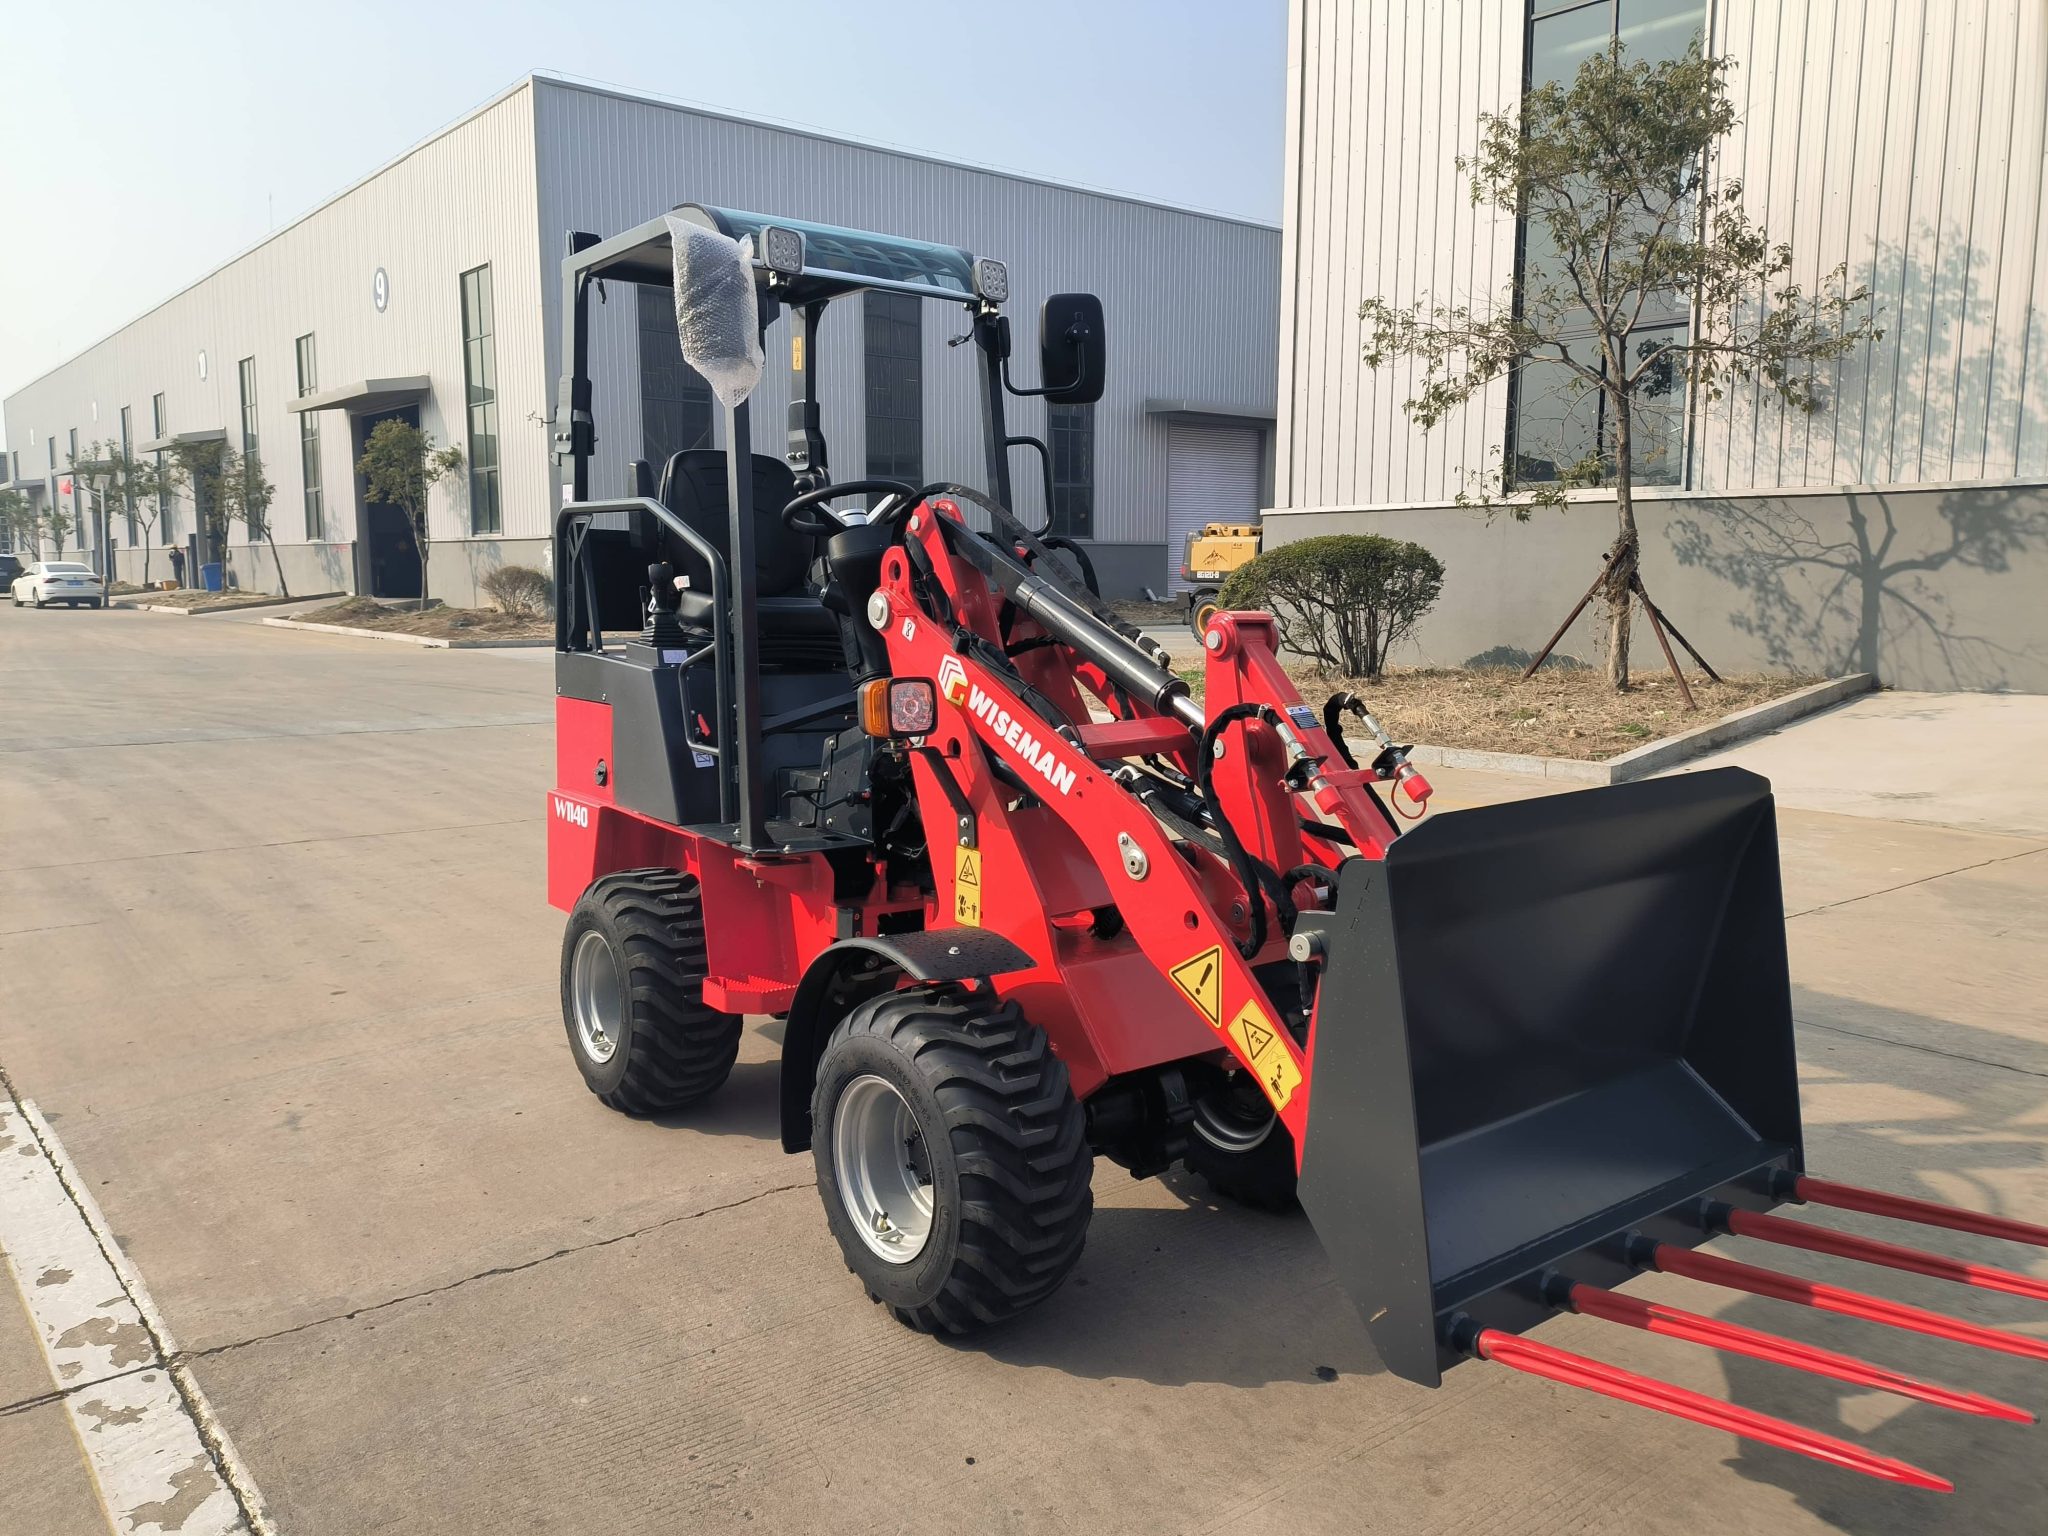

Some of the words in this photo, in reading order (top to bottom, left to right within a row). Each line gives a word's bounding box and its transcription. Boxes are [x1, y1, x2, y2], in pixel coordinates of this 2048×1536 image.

[375, 271, 385, 308] 9
[967, 683, 1077, 796] WISEMAN
[554, 796, 589, 828] W1140
